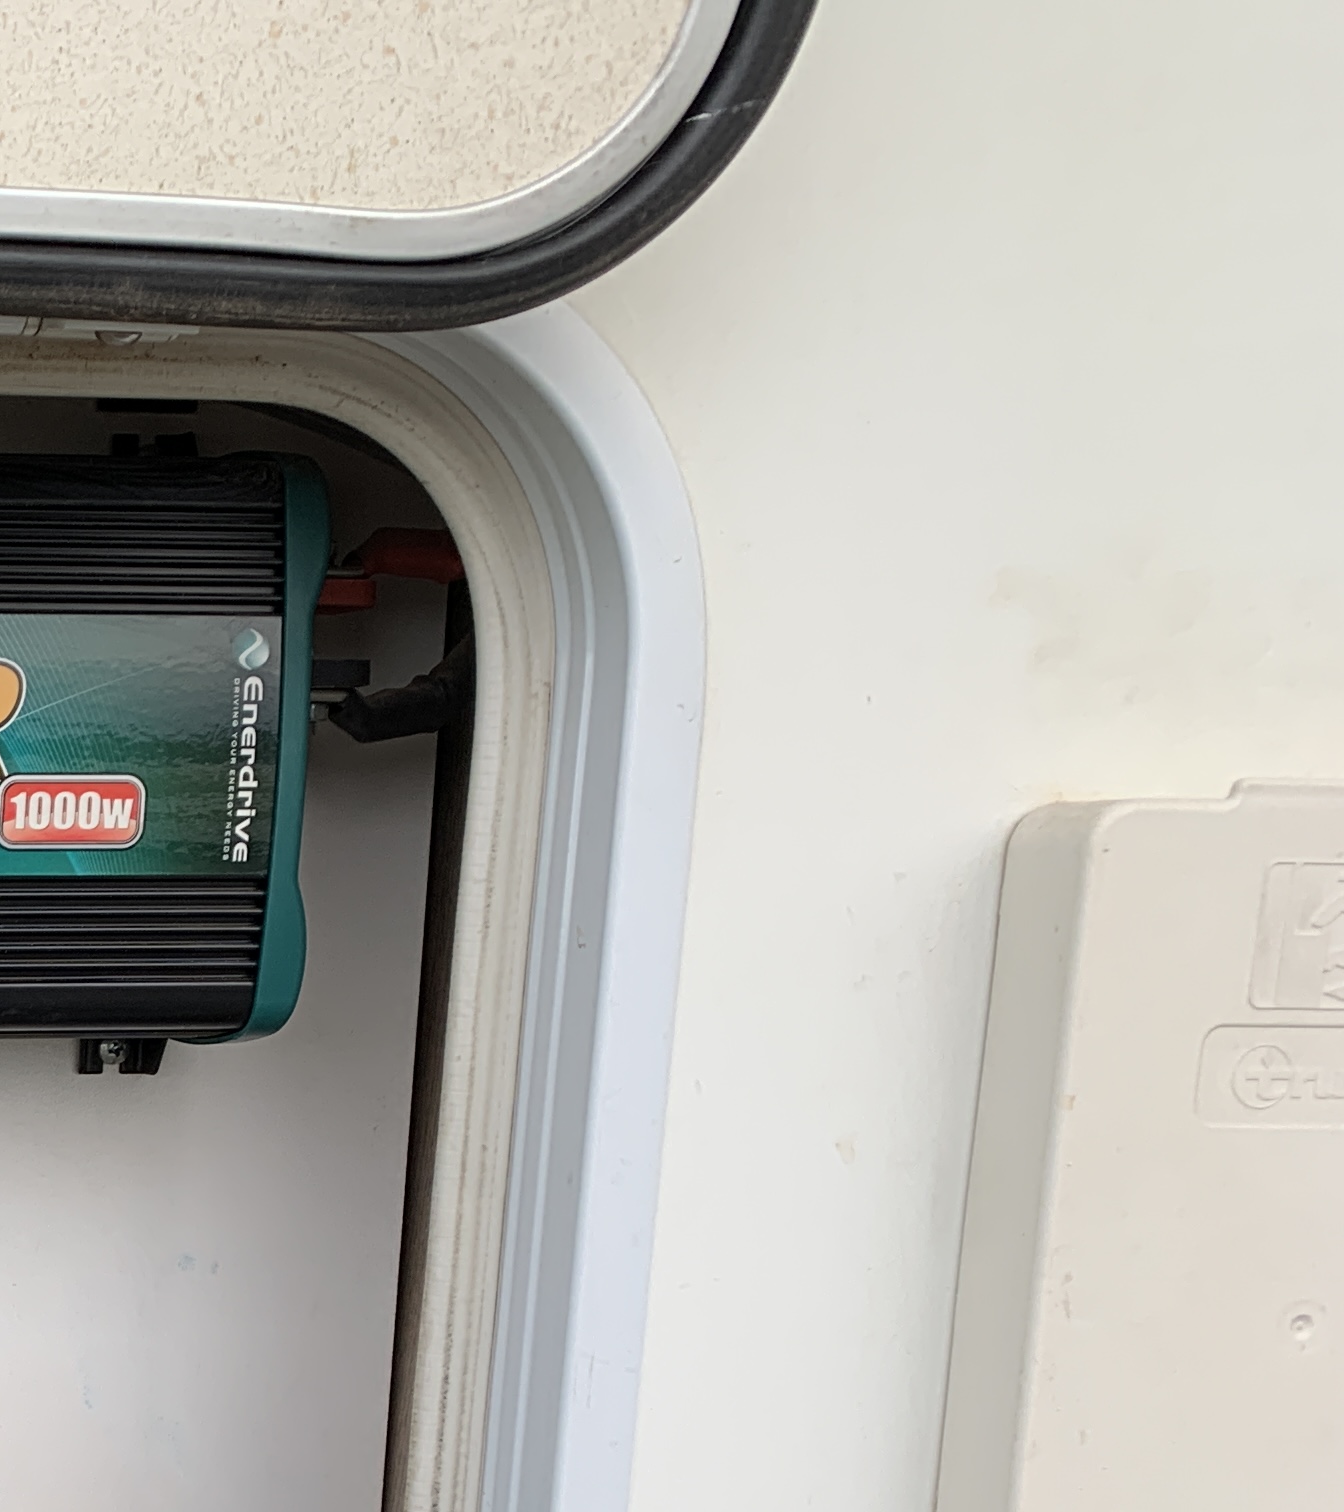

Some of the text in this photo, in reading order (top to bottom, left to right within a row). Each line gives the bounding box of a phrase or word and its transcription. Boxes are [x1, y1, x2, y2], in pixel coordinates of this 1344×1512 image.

[222, 677, 241, 861] DRIVING YOUR ENERGY NEEDS
[232, 675, 264, 864] Enerdrive
